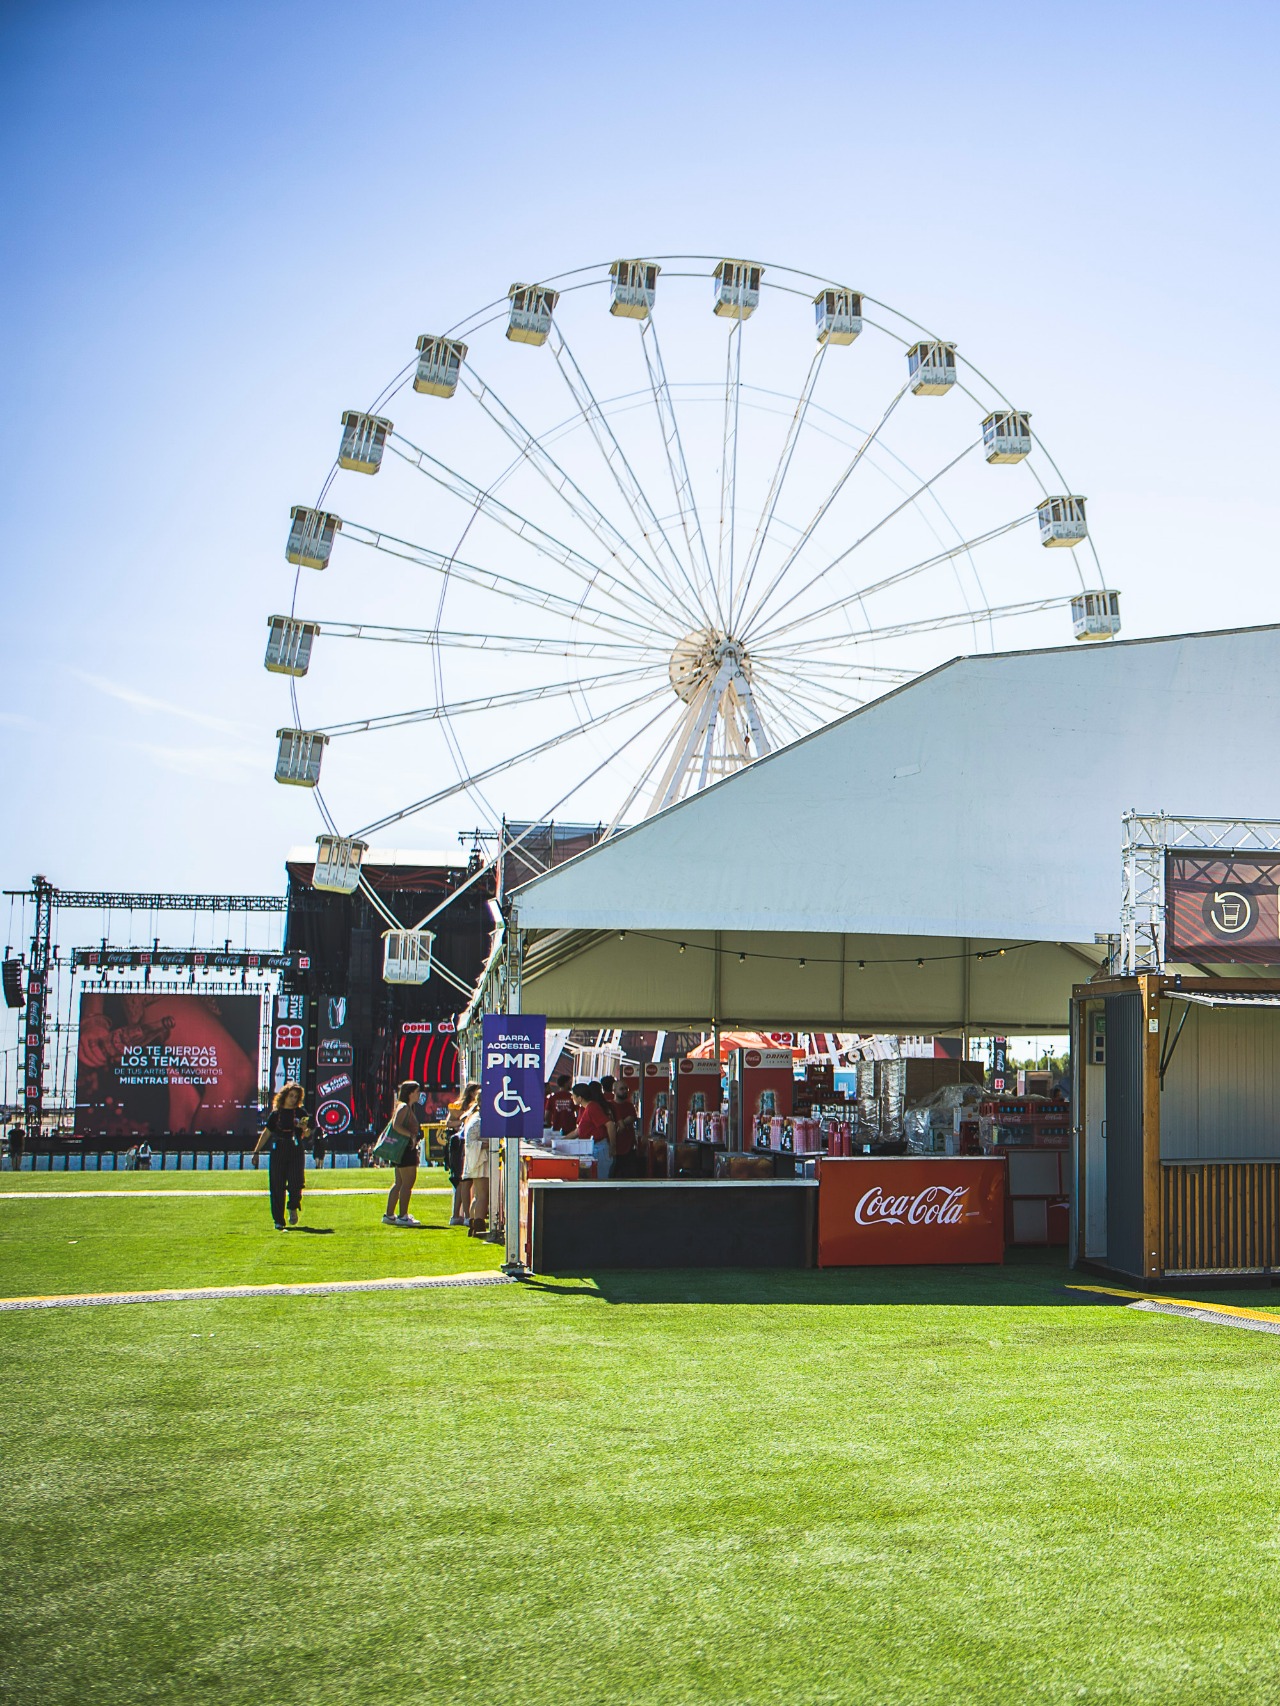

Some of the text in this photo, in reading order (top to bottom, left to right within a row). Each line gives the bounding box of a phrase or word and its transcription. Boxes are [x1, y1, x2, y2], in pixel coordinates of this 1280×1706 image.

[124, 1046, 216, 1056] NO TE PIERDAS
[121, 1056, 218, 1066] LOS TEMAZOS
[488, 1053, 540, 1068] PMR
[120, 1077, 218, 1085] MIENTRAS RECICLAS
[854, 1186, 970, 1225] Coca-Cola
